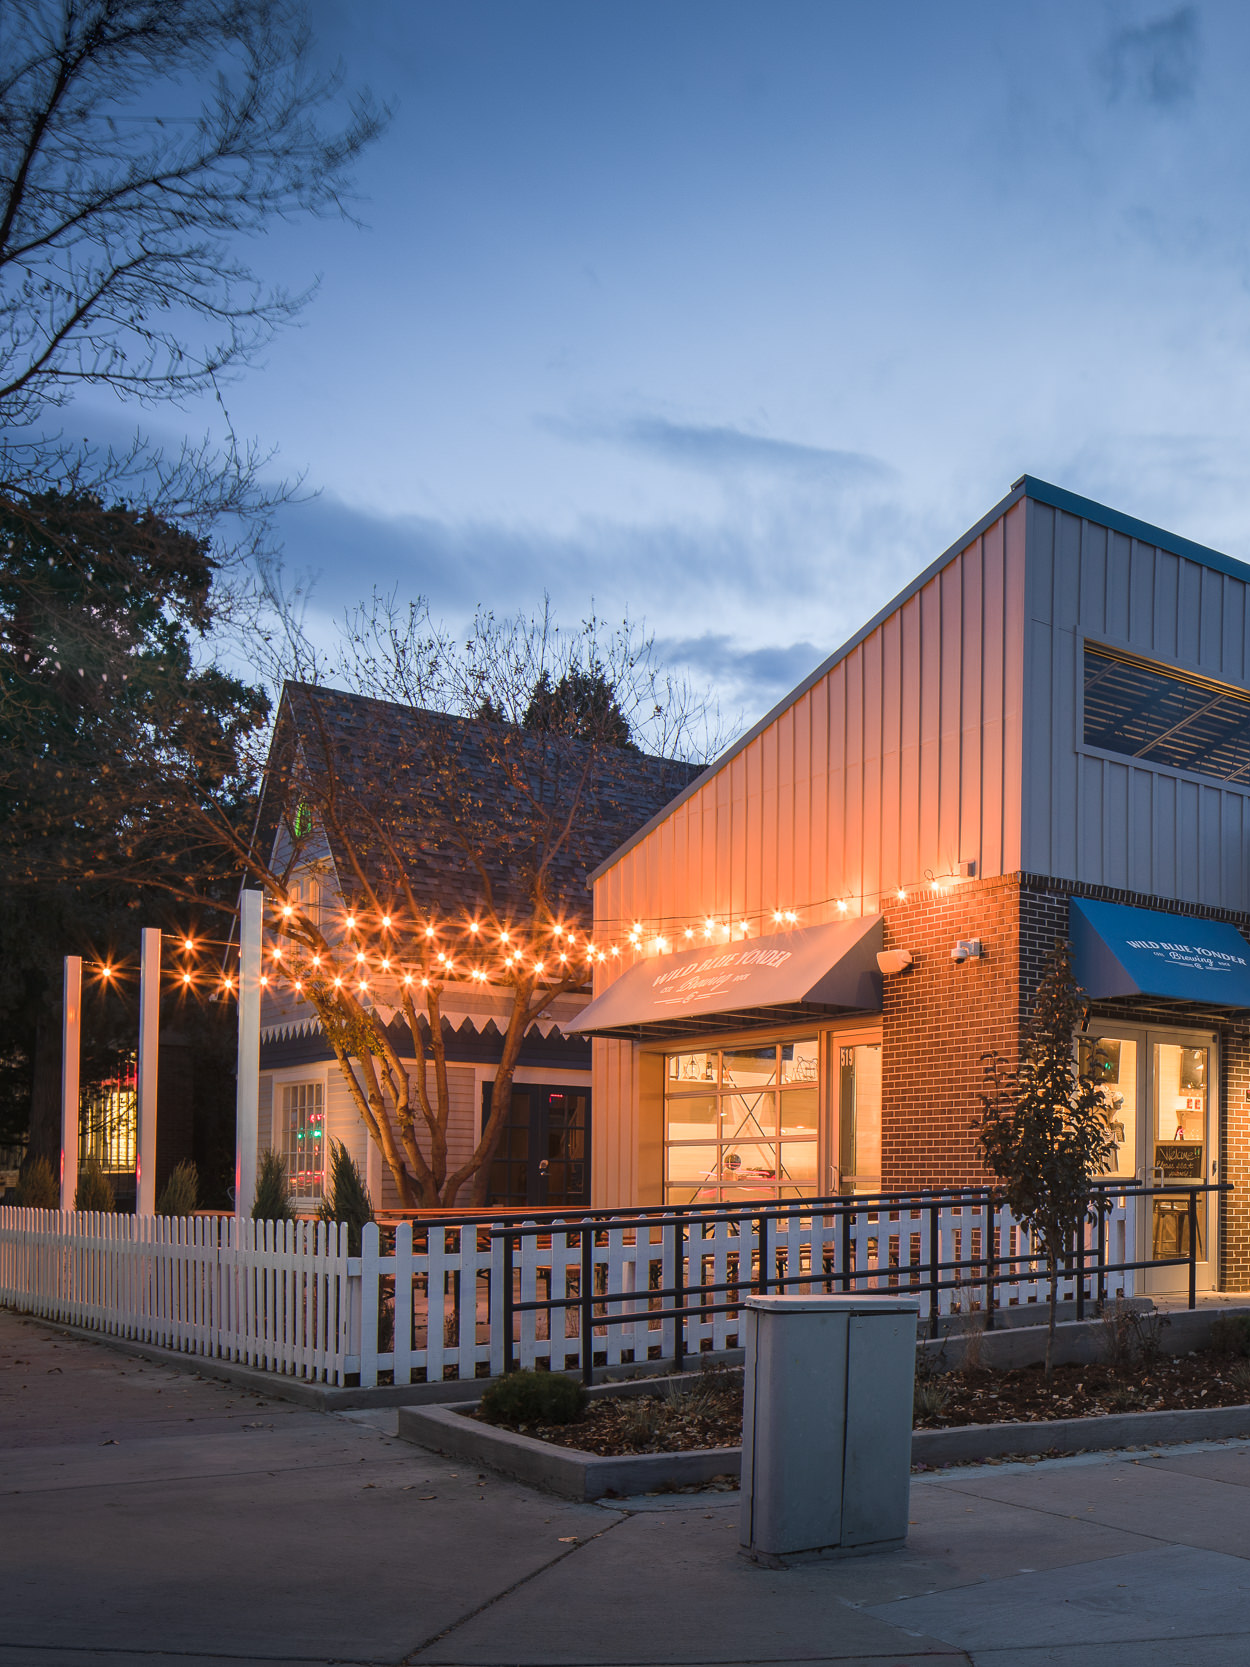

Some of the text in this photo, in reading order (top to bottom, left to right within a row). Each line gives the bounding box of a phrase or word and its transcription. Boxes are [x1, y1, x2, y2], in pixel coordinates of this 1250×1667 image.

[1126, 940, 1160, 949] WILD
[1160, 942, 1193, 953] BLUE
[1192, 946, 1247, 966] YONDER
[1168, 951, 1214, 967] Brewing
[652, 948, 792, 987] WILD BLUE YONDER
